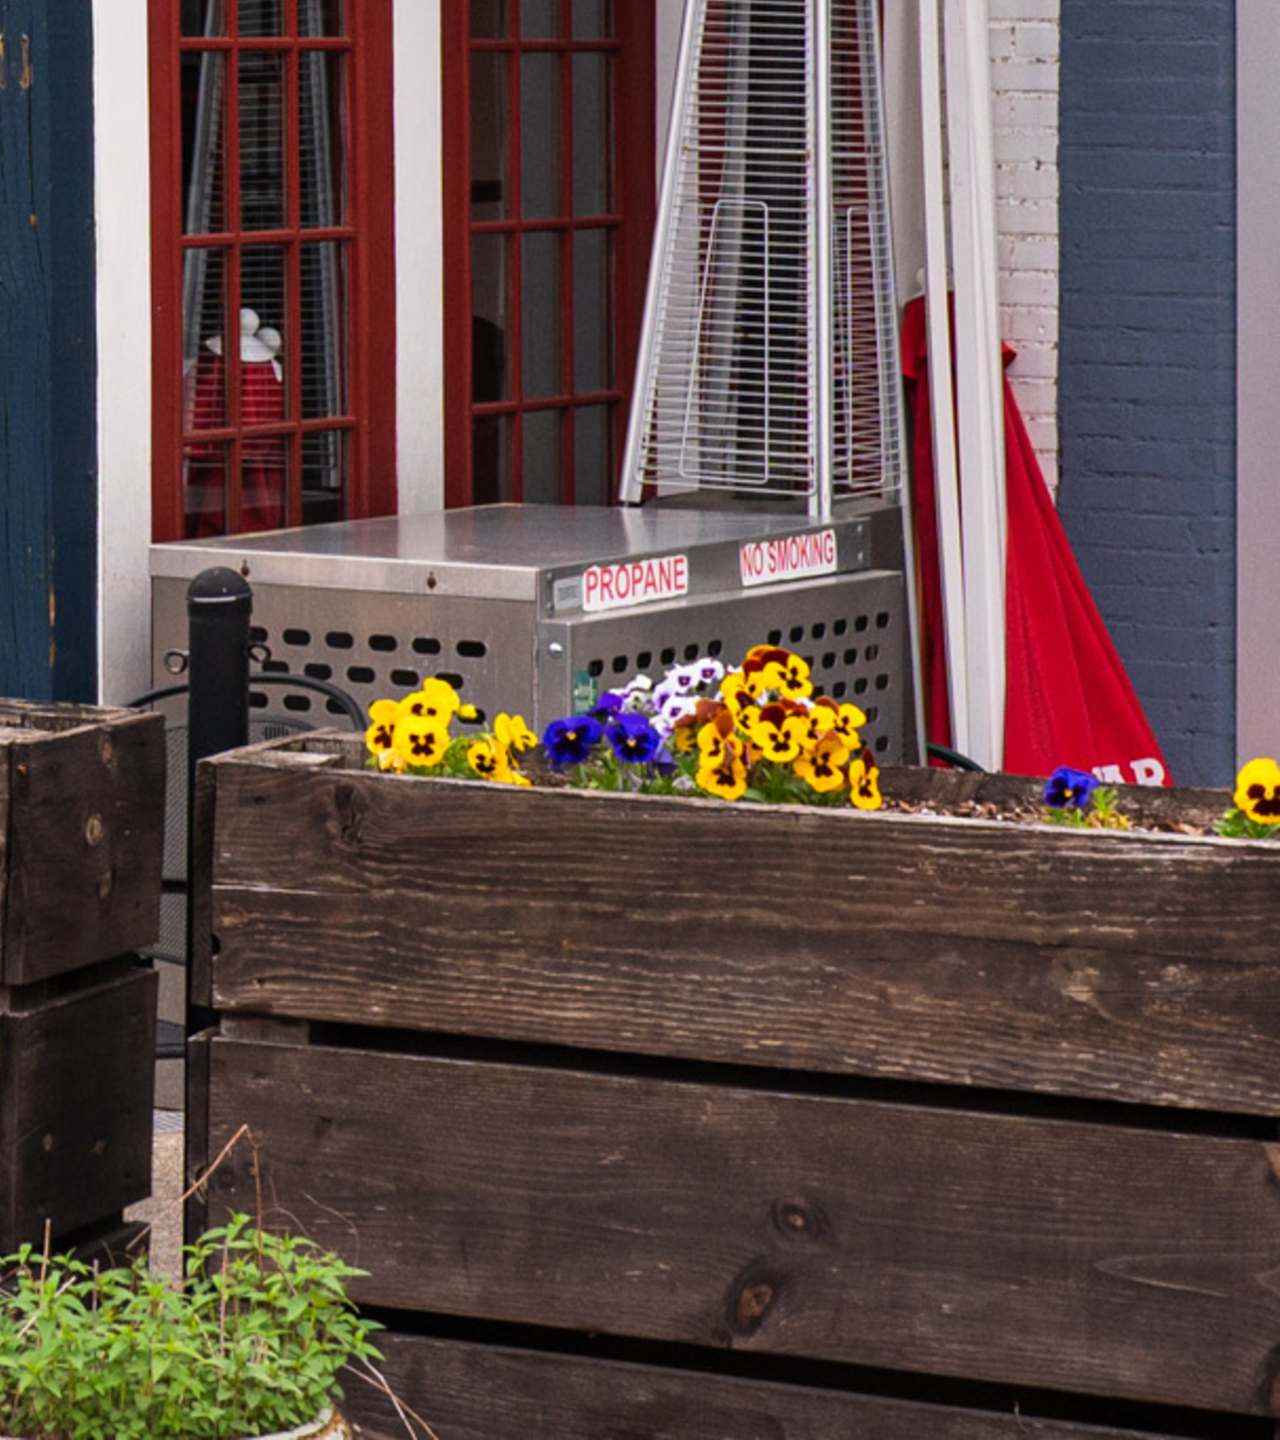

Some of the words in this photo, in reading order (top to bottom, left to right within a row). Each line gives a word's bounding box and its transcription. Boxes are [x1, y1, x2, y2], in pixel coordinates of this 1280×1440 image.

[740, 543, 763, 578] NO
[767, 532, 835, 570] SMOKING
[584, 558, 687, 604] PROPANE
